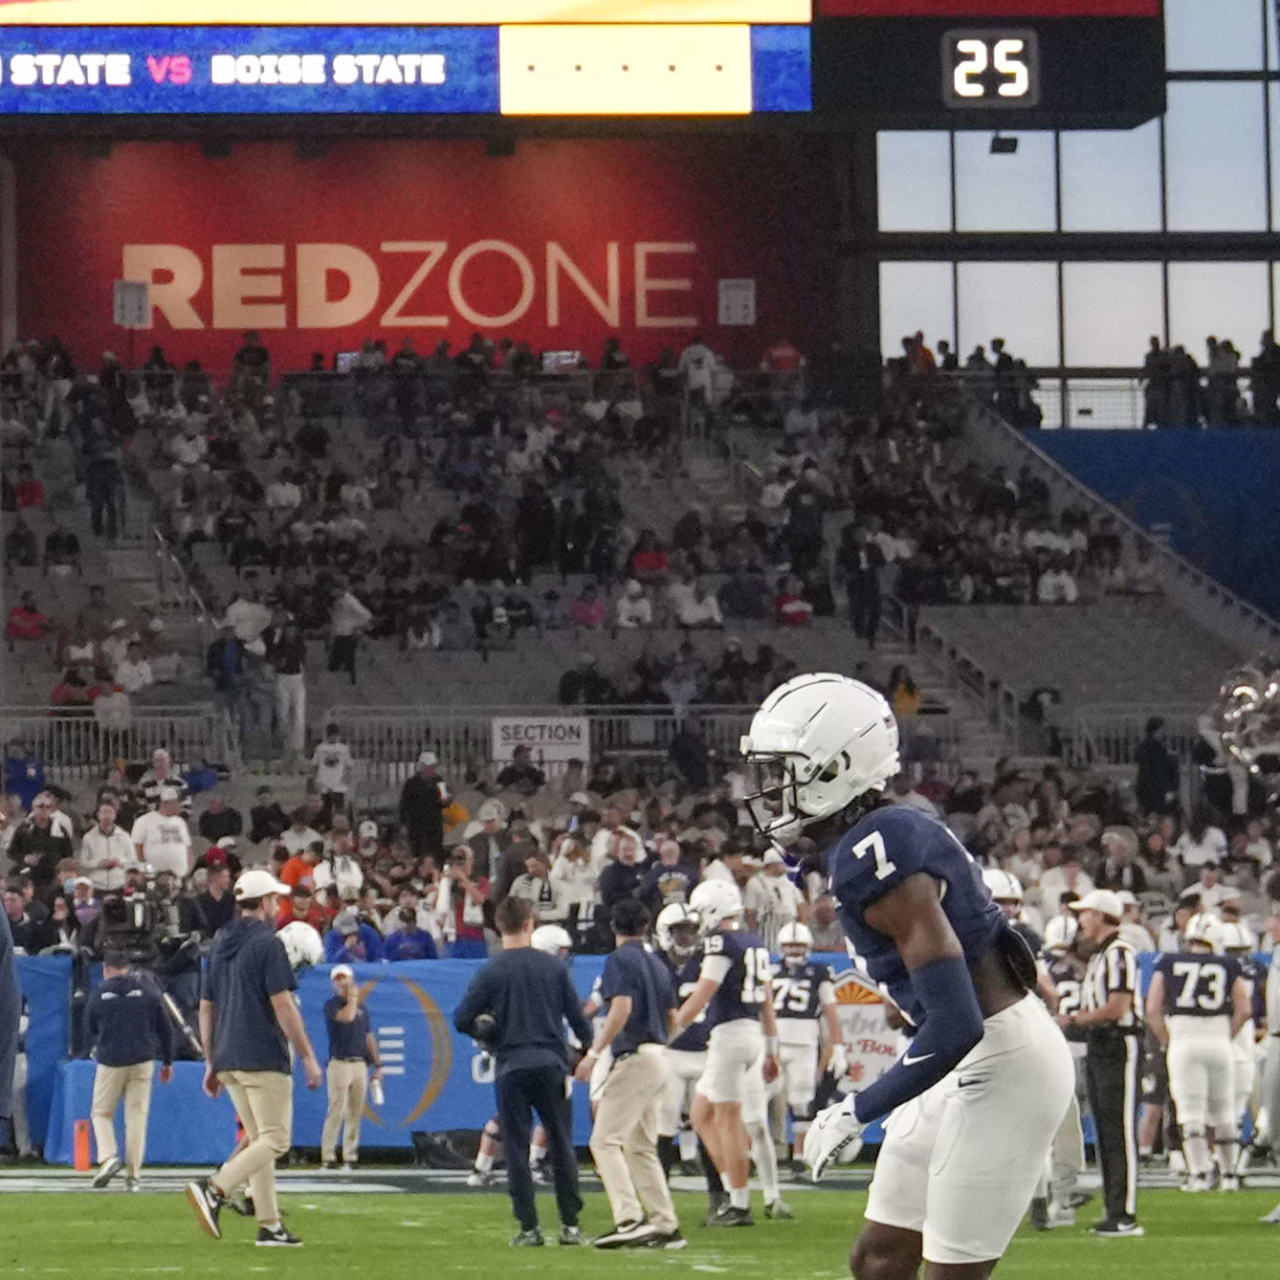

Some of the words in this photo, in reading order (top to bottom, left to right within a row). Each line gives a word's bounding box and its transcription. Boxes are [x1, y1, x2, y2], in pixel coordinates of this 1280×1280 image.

[9, 54, 131, 85] STATE
[147, 56, 192, 83] VS
[211, 54, 326, 84] BOISE
[332, 54, 446, 84] STATE
[953, 39, 1029, 97] 25
[501, 724, 581, 741] SECTION
[851, 830, 897, 881] 7
[771, 977, 812, 1012] 75
[1173, 961, 1227, 1011] 73
